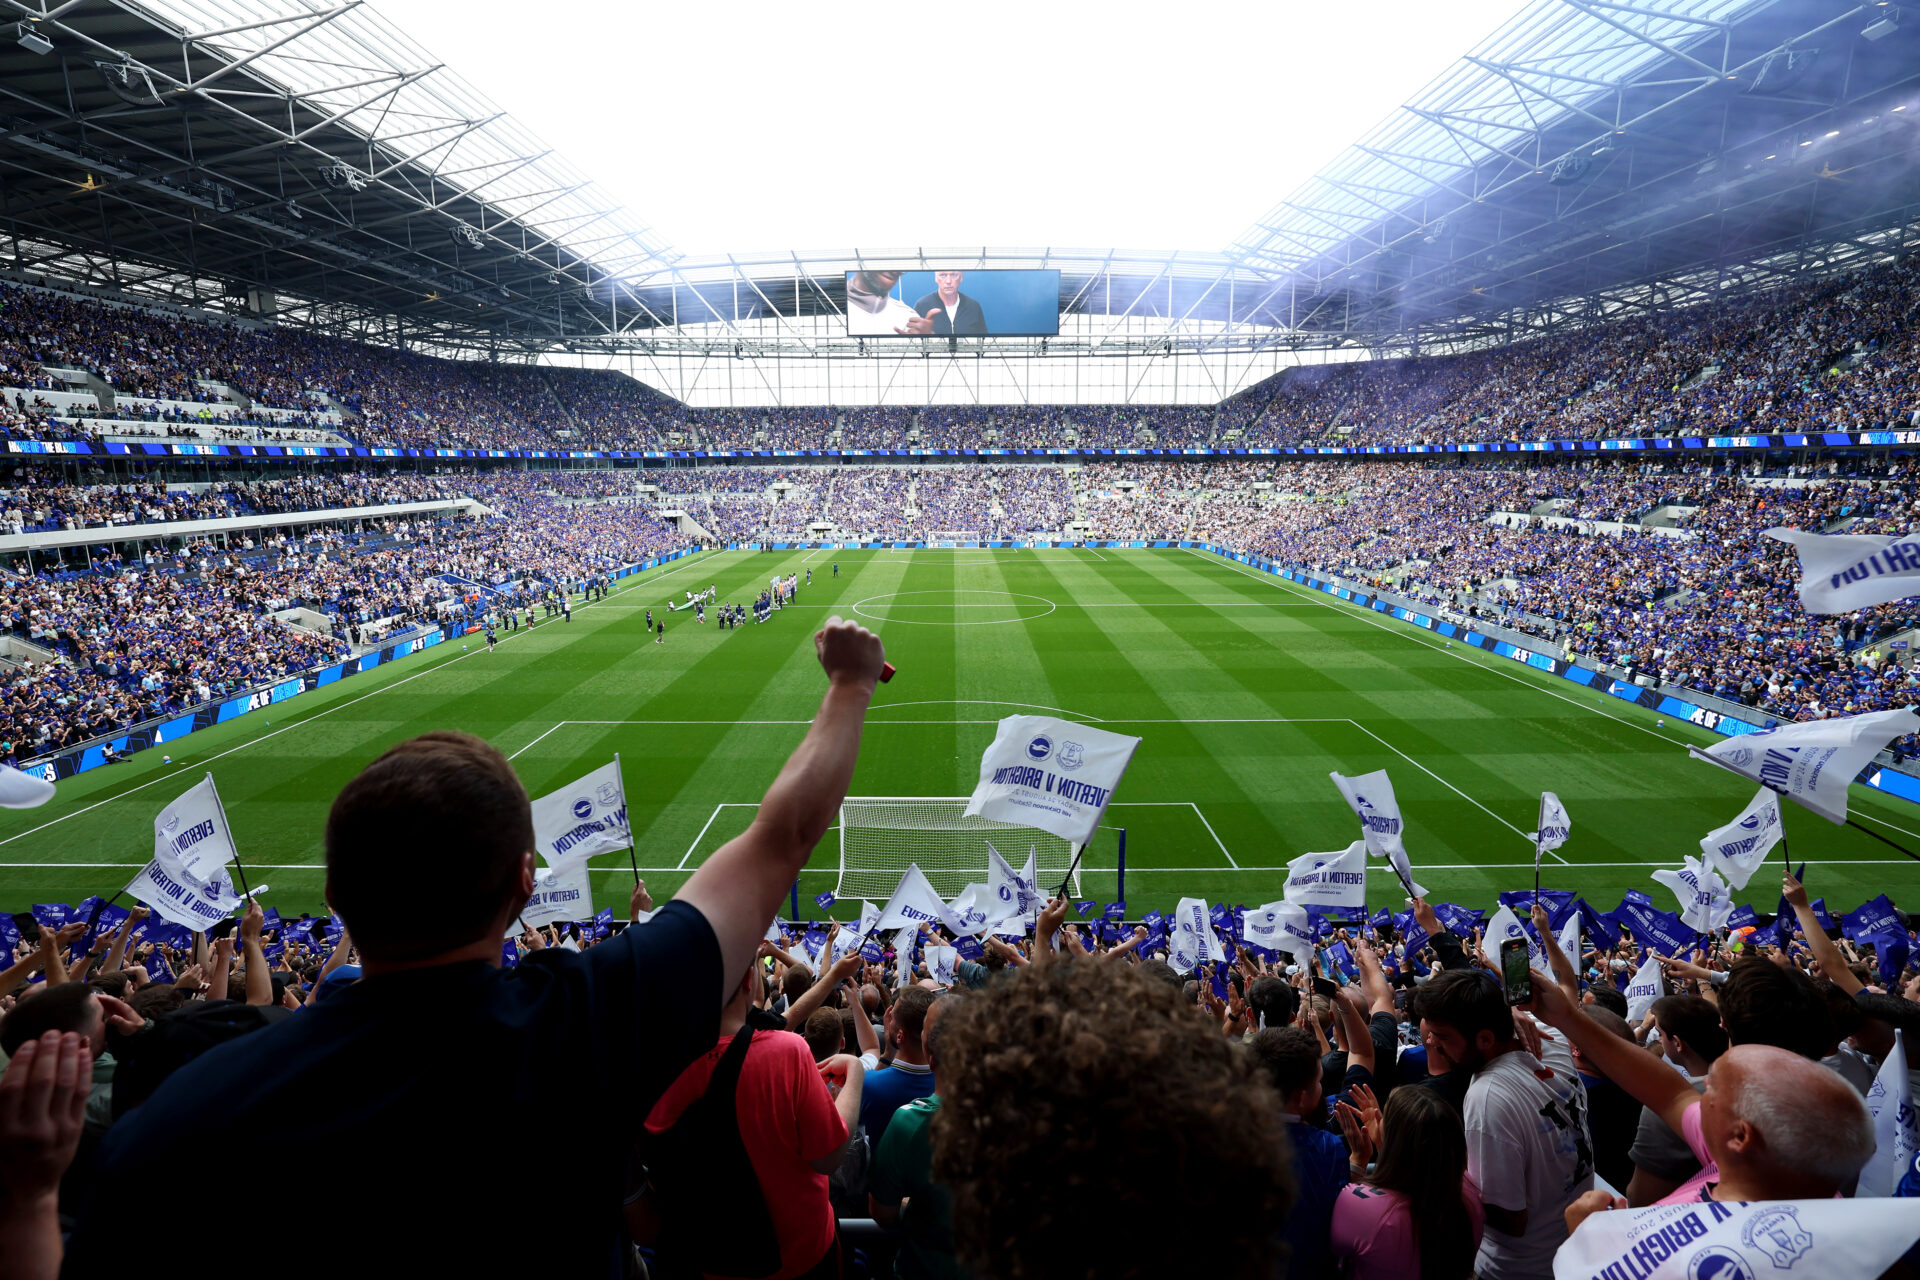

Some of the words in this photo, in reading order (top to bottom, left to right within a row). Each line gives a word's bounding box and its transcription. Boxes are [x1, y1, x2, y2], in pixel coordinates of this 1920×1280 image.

[260, 690, 270, 706] OF
[1704, 710, 1718, 729] OF
[1800, 746, 1819, 766] AUGUS
[148, 862, 185, 901] EVERTON
[182, 892, 195, 906] V
[1707, 1200, 1732, 1224] V
[1627, 1219, 1656, 1240] 2025
